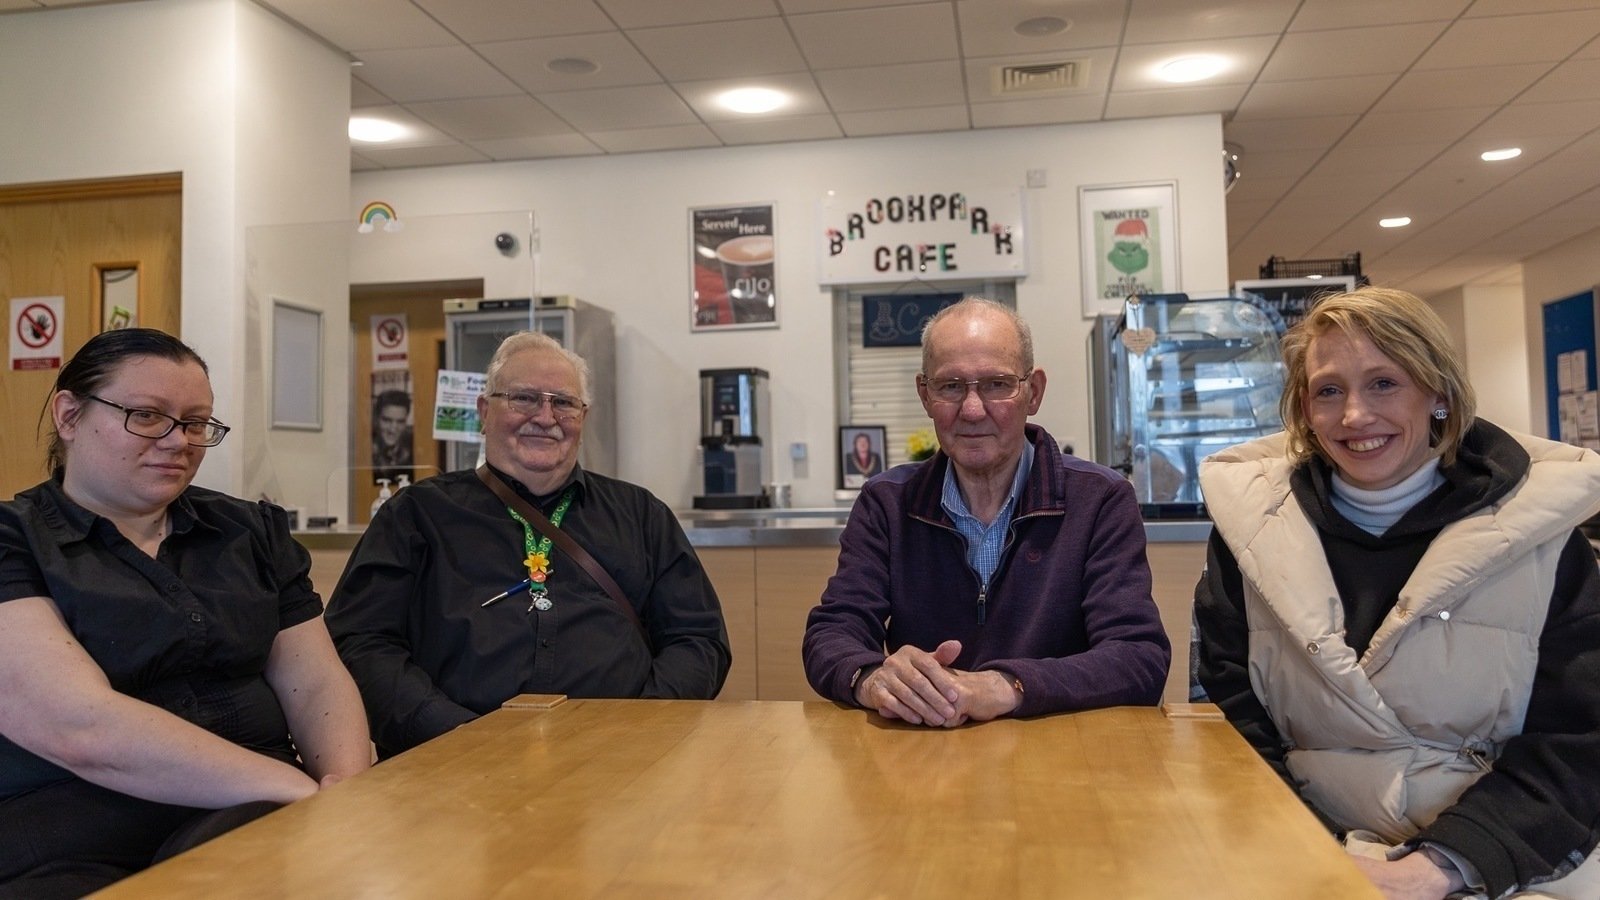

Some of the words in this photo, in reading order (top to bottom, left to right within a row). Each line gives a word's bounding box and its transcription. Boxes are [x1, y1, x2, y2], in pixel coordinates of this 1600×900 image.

[701, 216, 739, 231] Served
[739, 223, 767, 234] Here
[829, 192, 1013, 257] BROOKPARK
[1101, 209, 1150, 220] WANTED
[874, 243, 958, 273] CAFE
